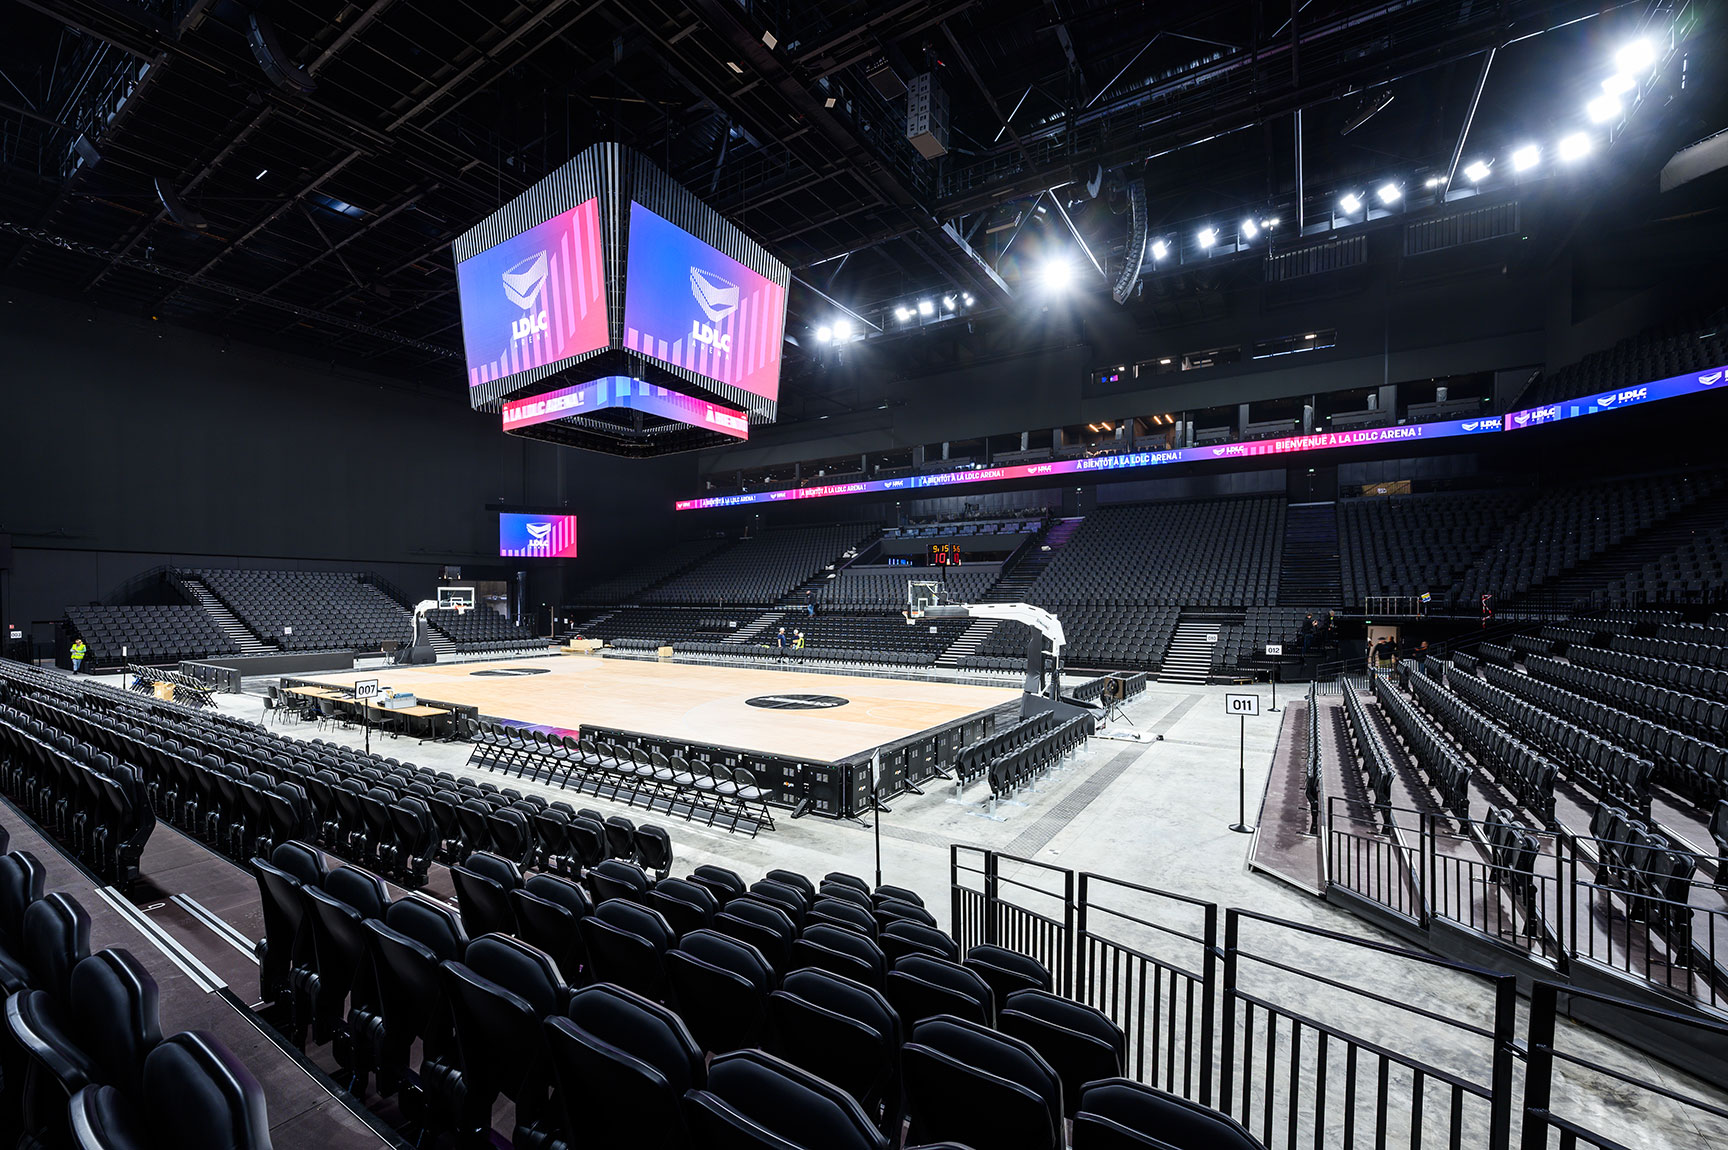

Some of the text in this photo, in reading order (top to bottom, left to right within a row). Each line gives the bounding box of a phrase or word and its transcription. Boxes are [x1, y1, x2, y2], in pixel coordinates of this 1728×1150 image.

[512, 310, 548, 340] LDLC
[693, 320, 731, 353] LDLC
[1618, 388, 1647, 400] LDLC
[1531, 408, 1555, 419] LDLC
[1275, 436, 1328, 450] BIENVENUE
[1329, 434, 1337, 445] À
[1339, 434, 1351, 444] LA
[1353, 431, 1378, 442] LDLC
[1380, 427, 1416, 440] ARENA
[1120, 456, 1130, 465] LA
[1131, 455, 1150, 464] LDLC
[1151, 453, 1177, 462] ARENA
[980, 470, 1001, 479] ARENA
[358, 684, 376, 696] 007
[1232, 699, 1252, 711] 011
